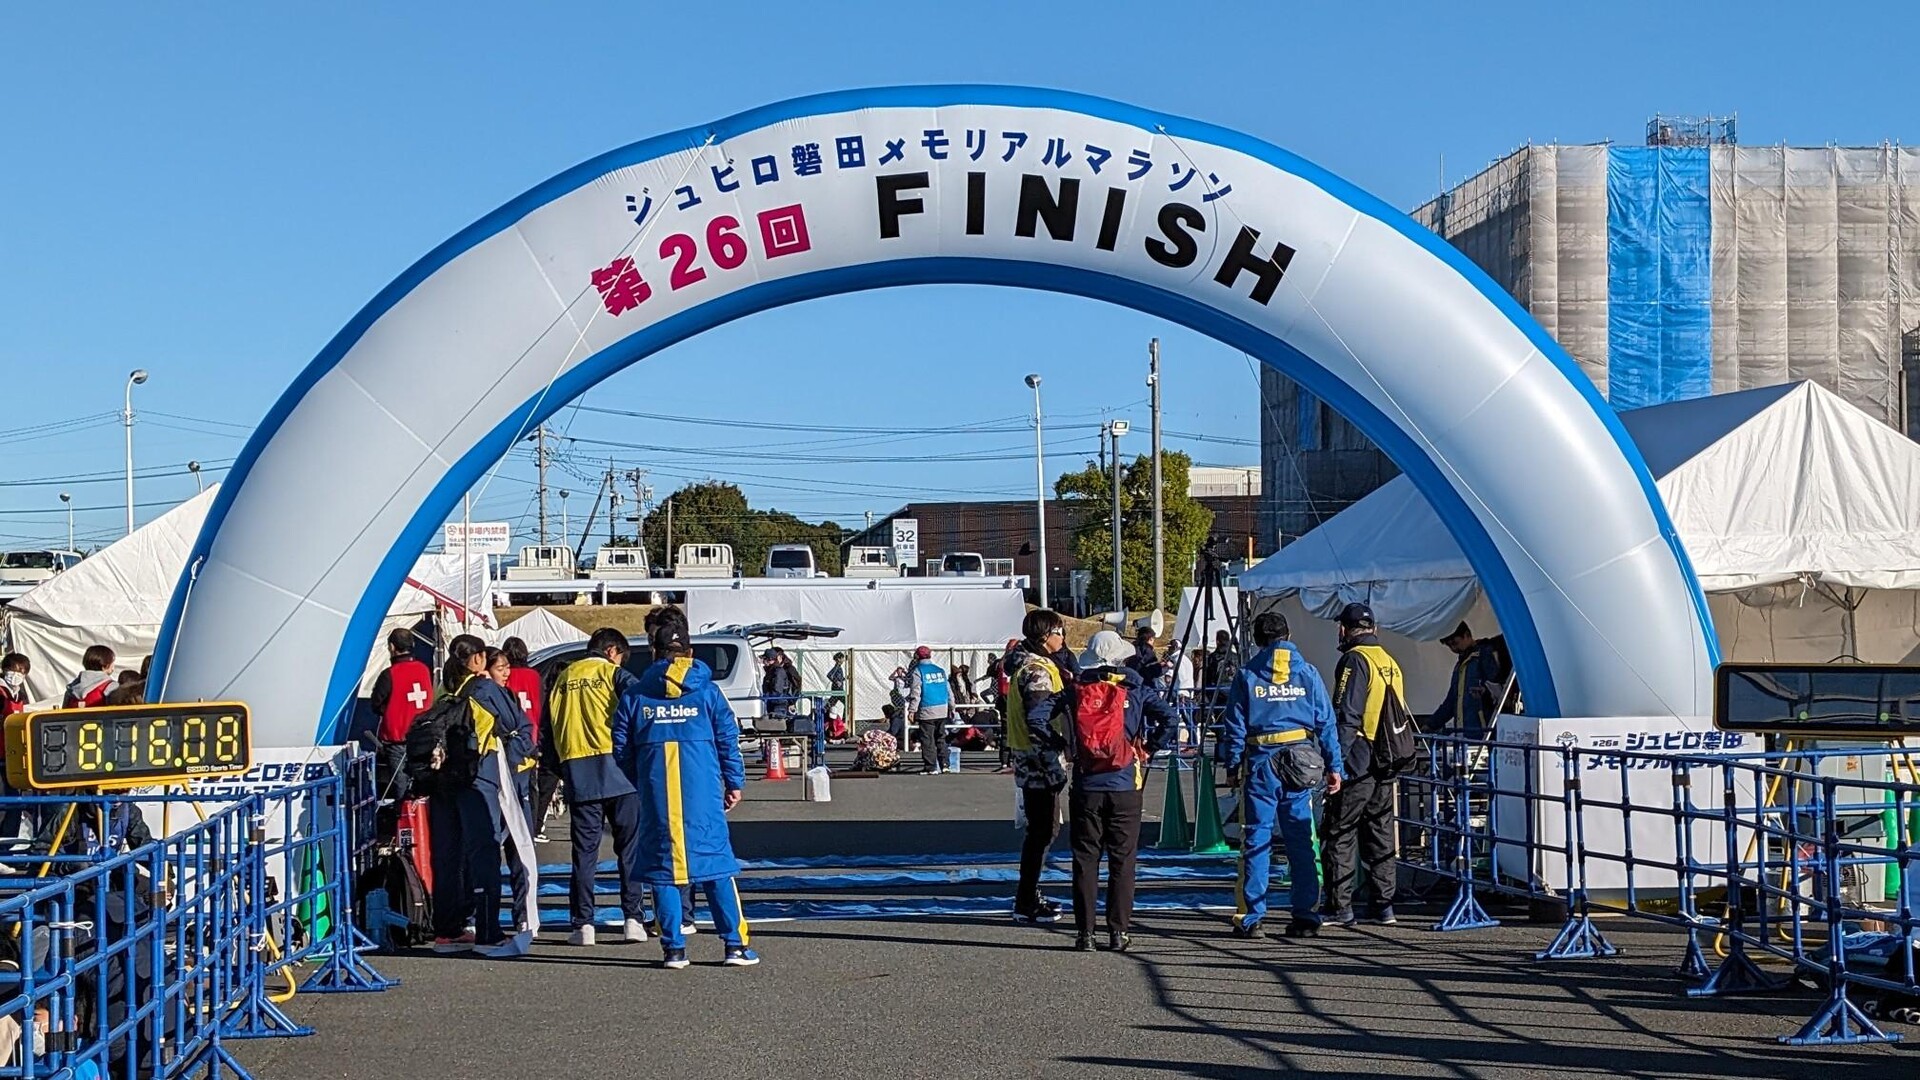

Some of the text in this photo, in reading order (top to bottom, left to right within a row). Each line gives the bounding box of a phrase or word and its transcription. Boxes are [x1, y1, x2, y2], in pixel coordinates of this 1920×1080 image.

[624, 129, 1232, 226] ジュビロ磐田メモリアルマラソン
[590, 203, 812, 316] 第26回
[876, 171, 1296, 304] FINISH
[896, 530, 915, 542] 32
[656, 704, 699, 718] R-bies
[1269, 684, 1306, 697] R-bies
